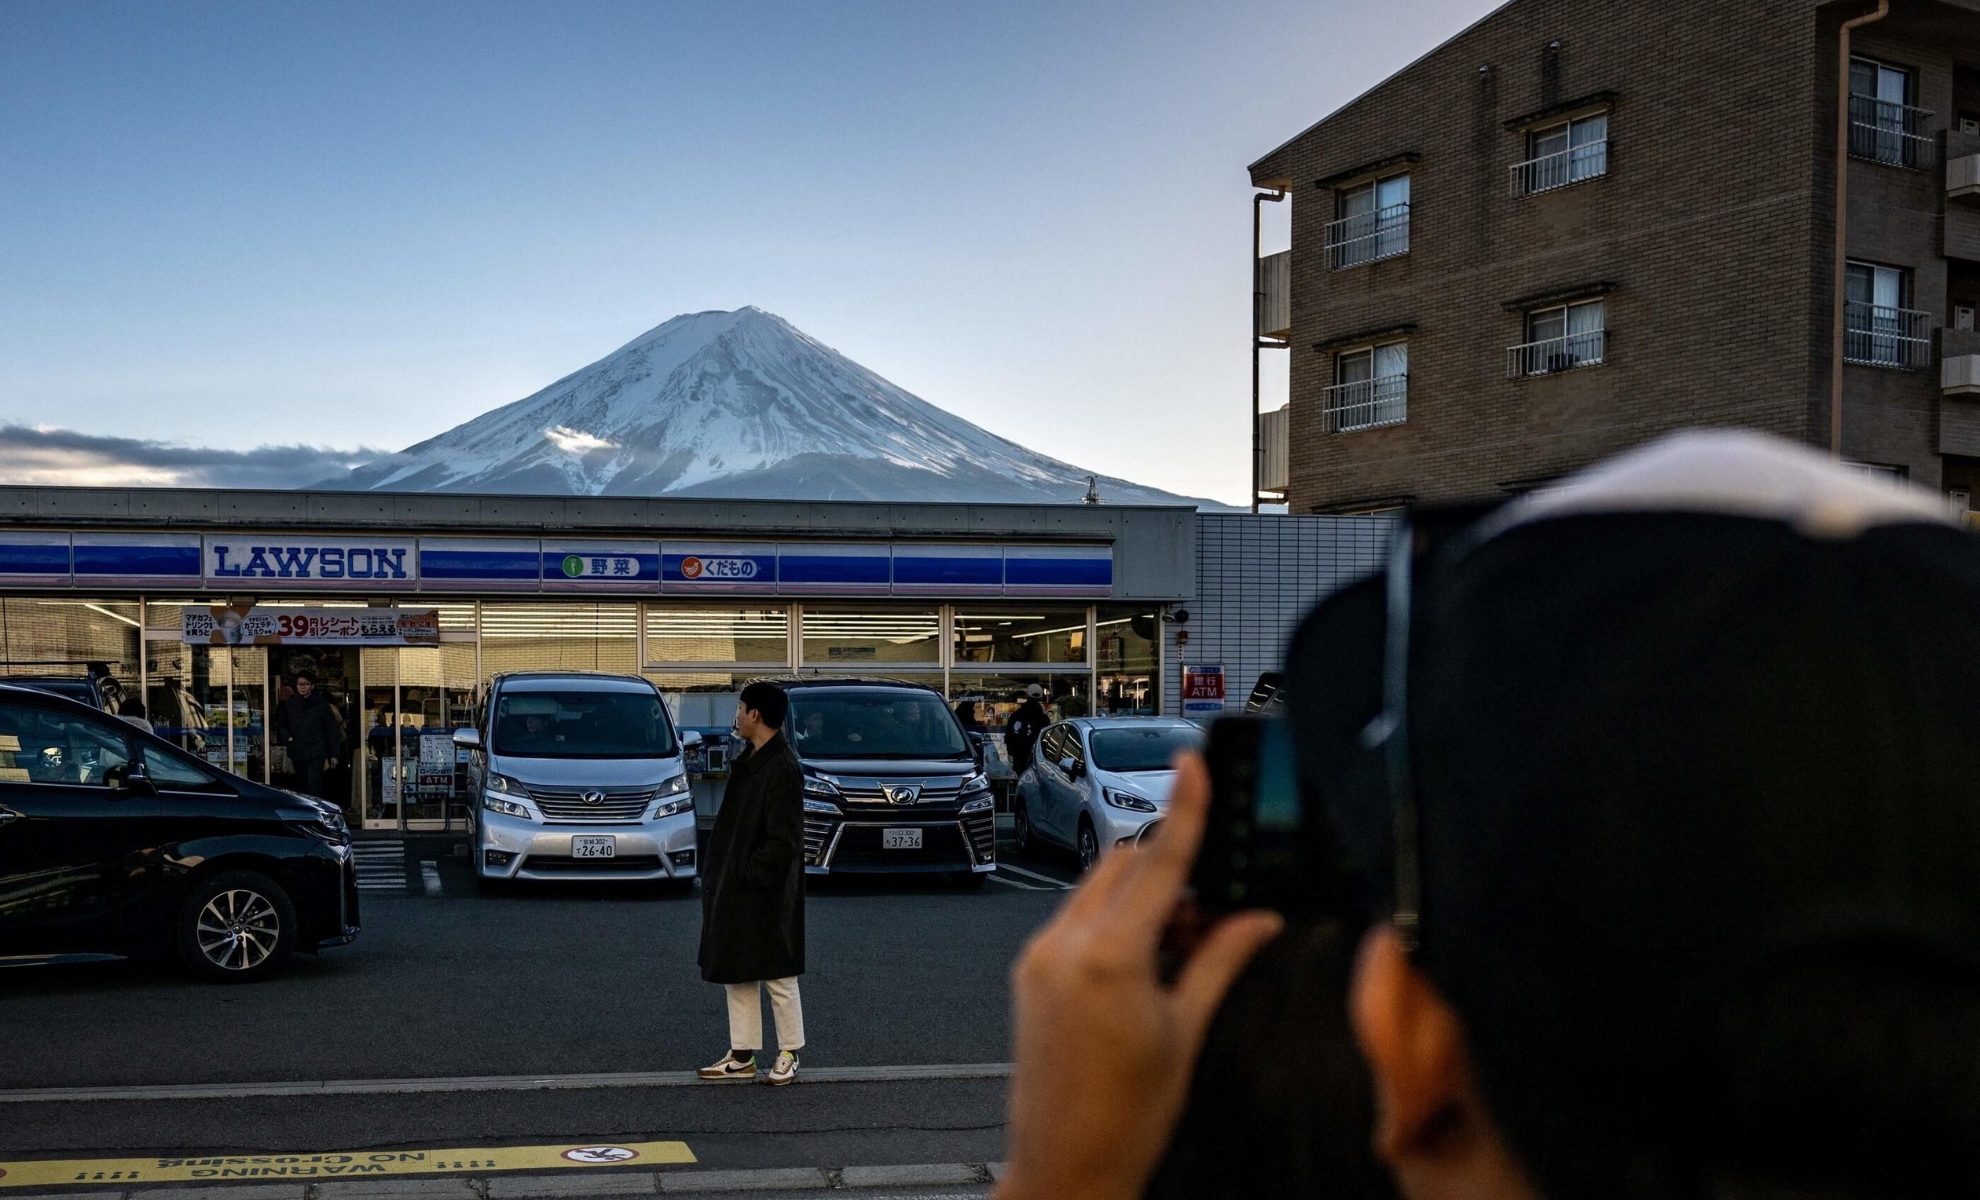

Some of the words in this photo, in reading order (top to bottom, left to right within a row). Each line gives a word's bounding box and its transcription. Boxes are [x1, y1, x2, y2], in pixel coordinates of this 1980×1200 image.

[214, 546, 406, 578] LAWSON
[591, 558, 630, 575] 野菜
[705, 560, 752, 576] くだもの
[277, 615, 309, 636] 39
[320, 616, 359, 627] レシート
[320, 626, 359, 636] クーポン
[361, 624, 396, 634] もらえる
[1194, 676, 1216, 686] 銀行
[1192, 687, 1217, 697] ATM
[426, 776, 448, 784] ATM
[892, 836, 920, 847] 37-36
[582, 845, 613, 856] 26-40
[157, 1155, 354, 1168] Crossing
[368, 1153, 425, 1161] NO
[191, 1164, 386, 1177] WARNING
